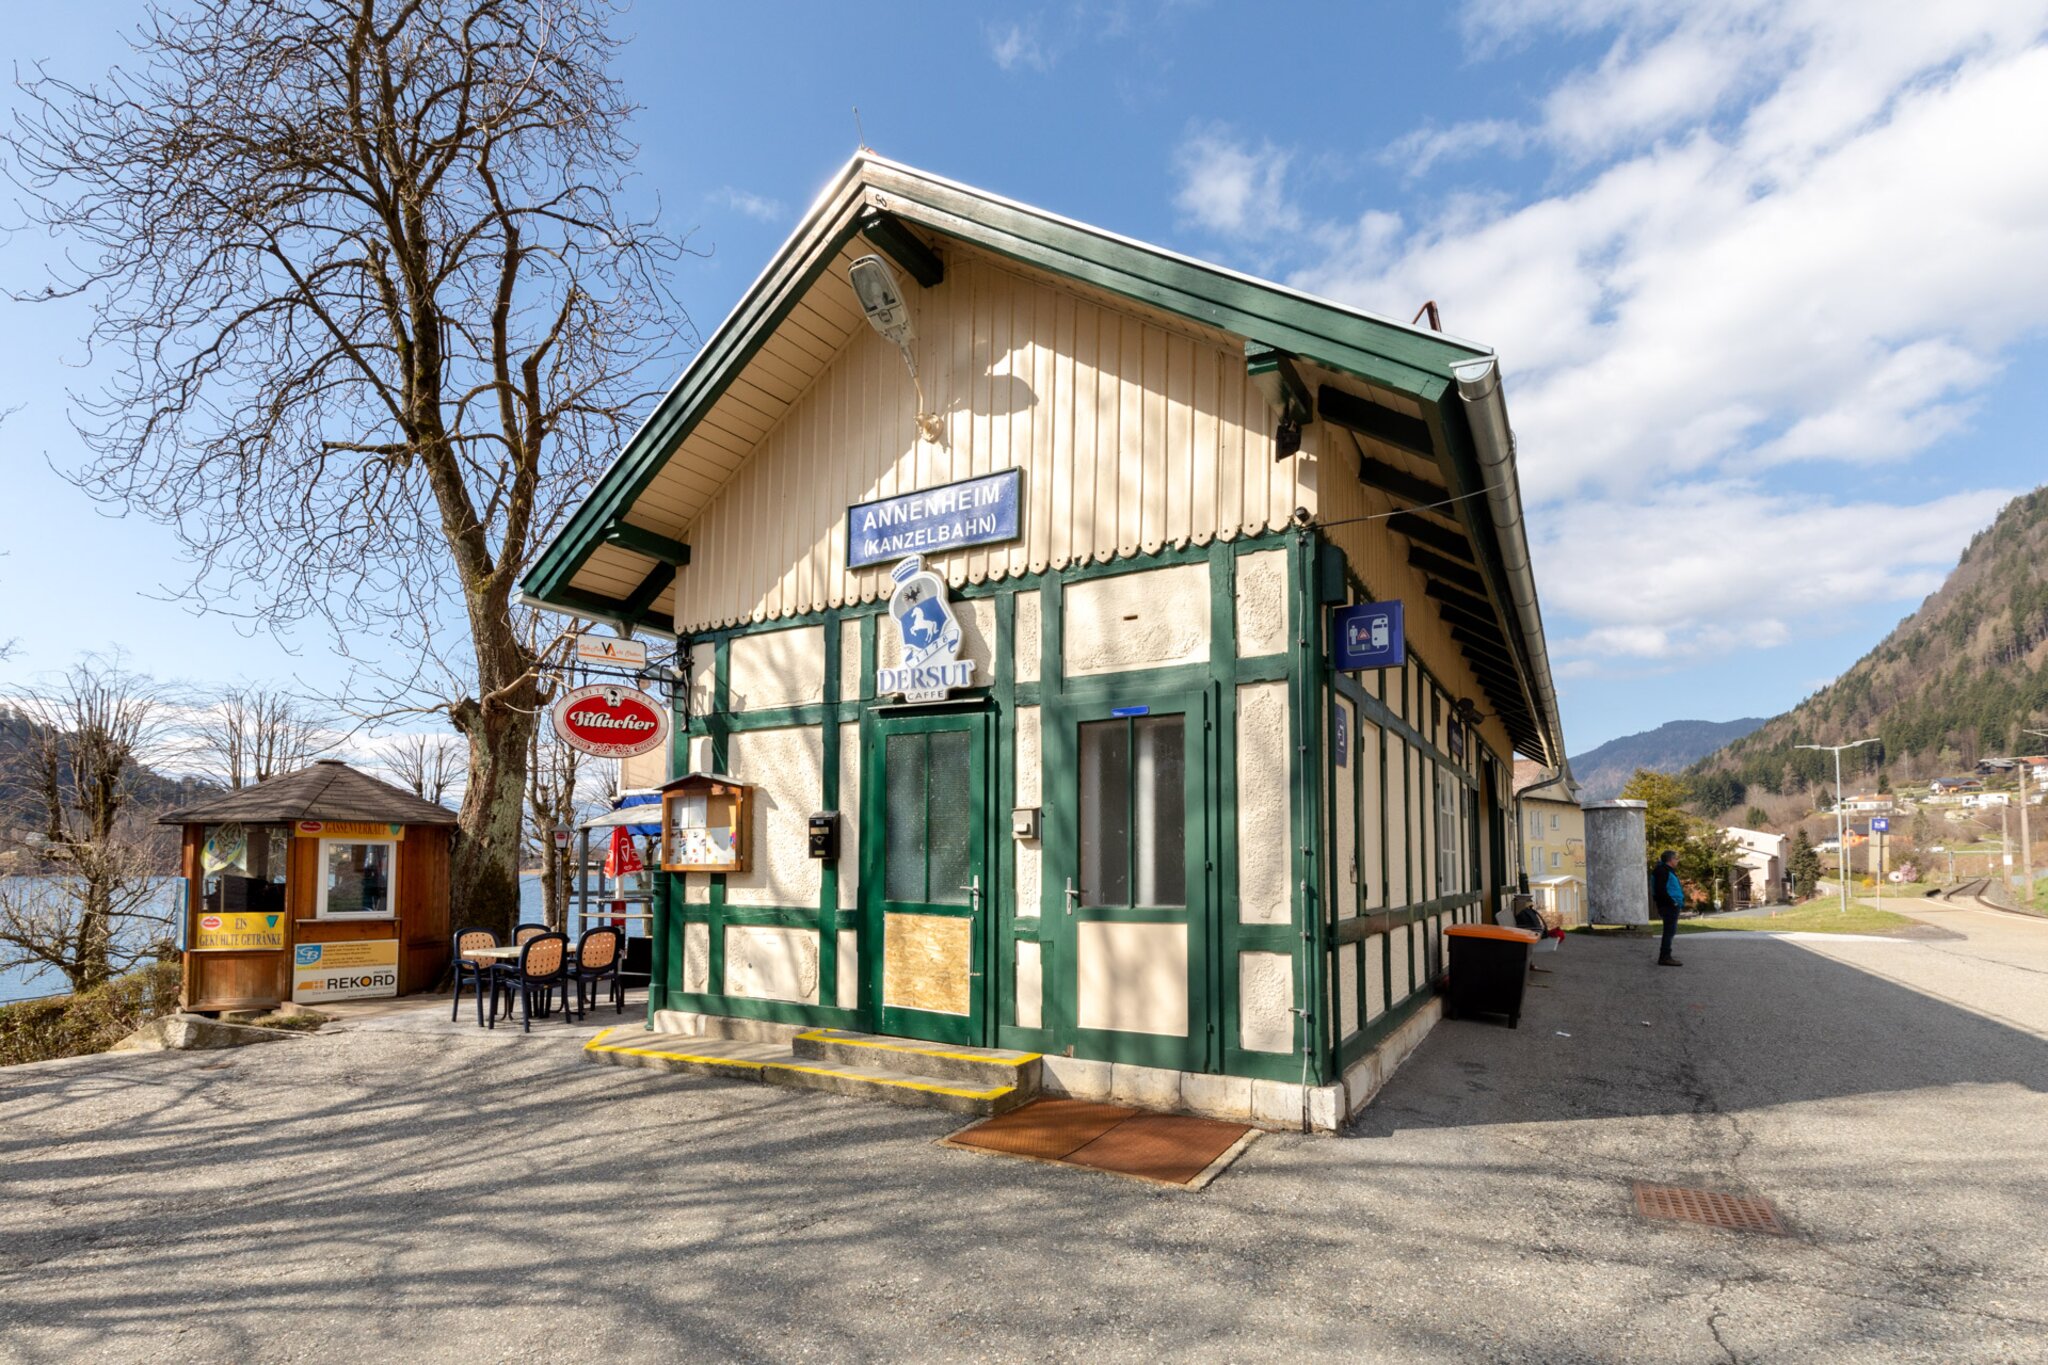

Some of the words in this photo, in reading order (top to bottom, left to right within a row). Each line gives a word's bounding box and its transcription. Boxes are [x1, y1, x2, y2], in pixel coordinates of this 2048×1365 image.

[862, 482, 1001, 532] ANNENHEIM
[864, 513, 997, 556] (KANZELBAHN)
[880, 662, 974, 692] DERSUT
[569, 711, 655, 731] Villacher
[235, 917, 248, 930] EIS
[199, 932, 240, 947] GEKÜHLTE
[241, 930, 283, 946] GETRÄNKE
[327, 974, 396, 990] REKORD
